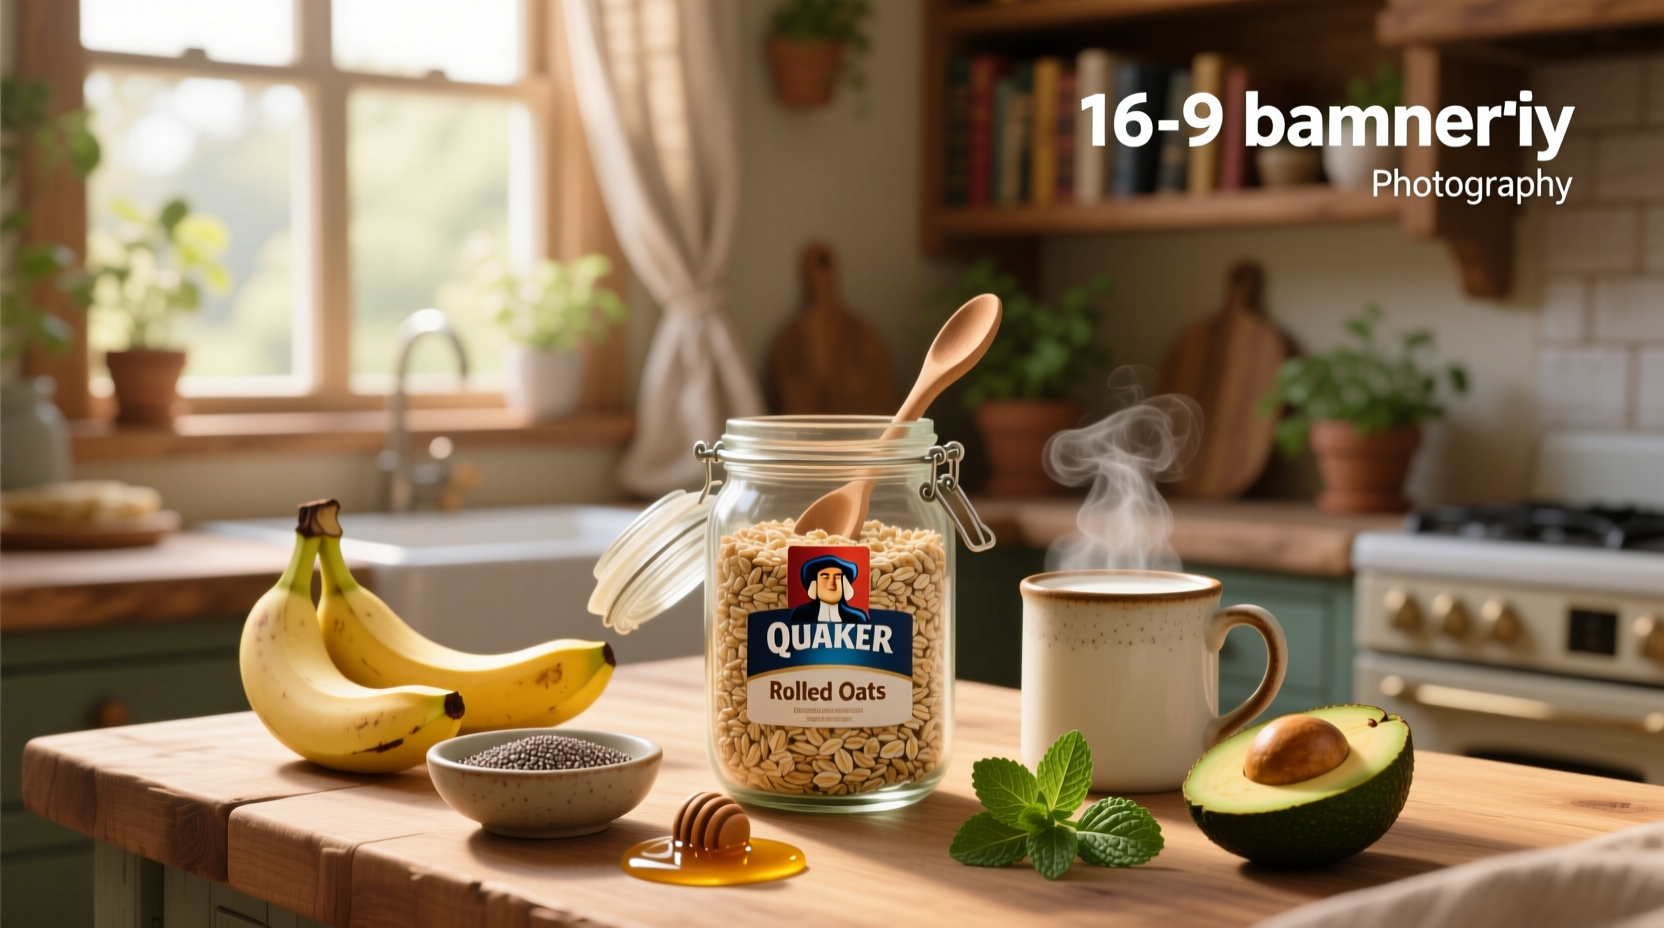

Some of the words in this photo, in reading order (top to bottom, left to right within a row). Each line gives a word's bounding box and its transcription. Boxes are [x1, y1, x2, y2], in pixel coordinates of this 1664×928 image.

[766, 621, 894, 659] QUAKER
[769, 680, 833, 702] Rolled
[838, 681, 886, 702] Oats
